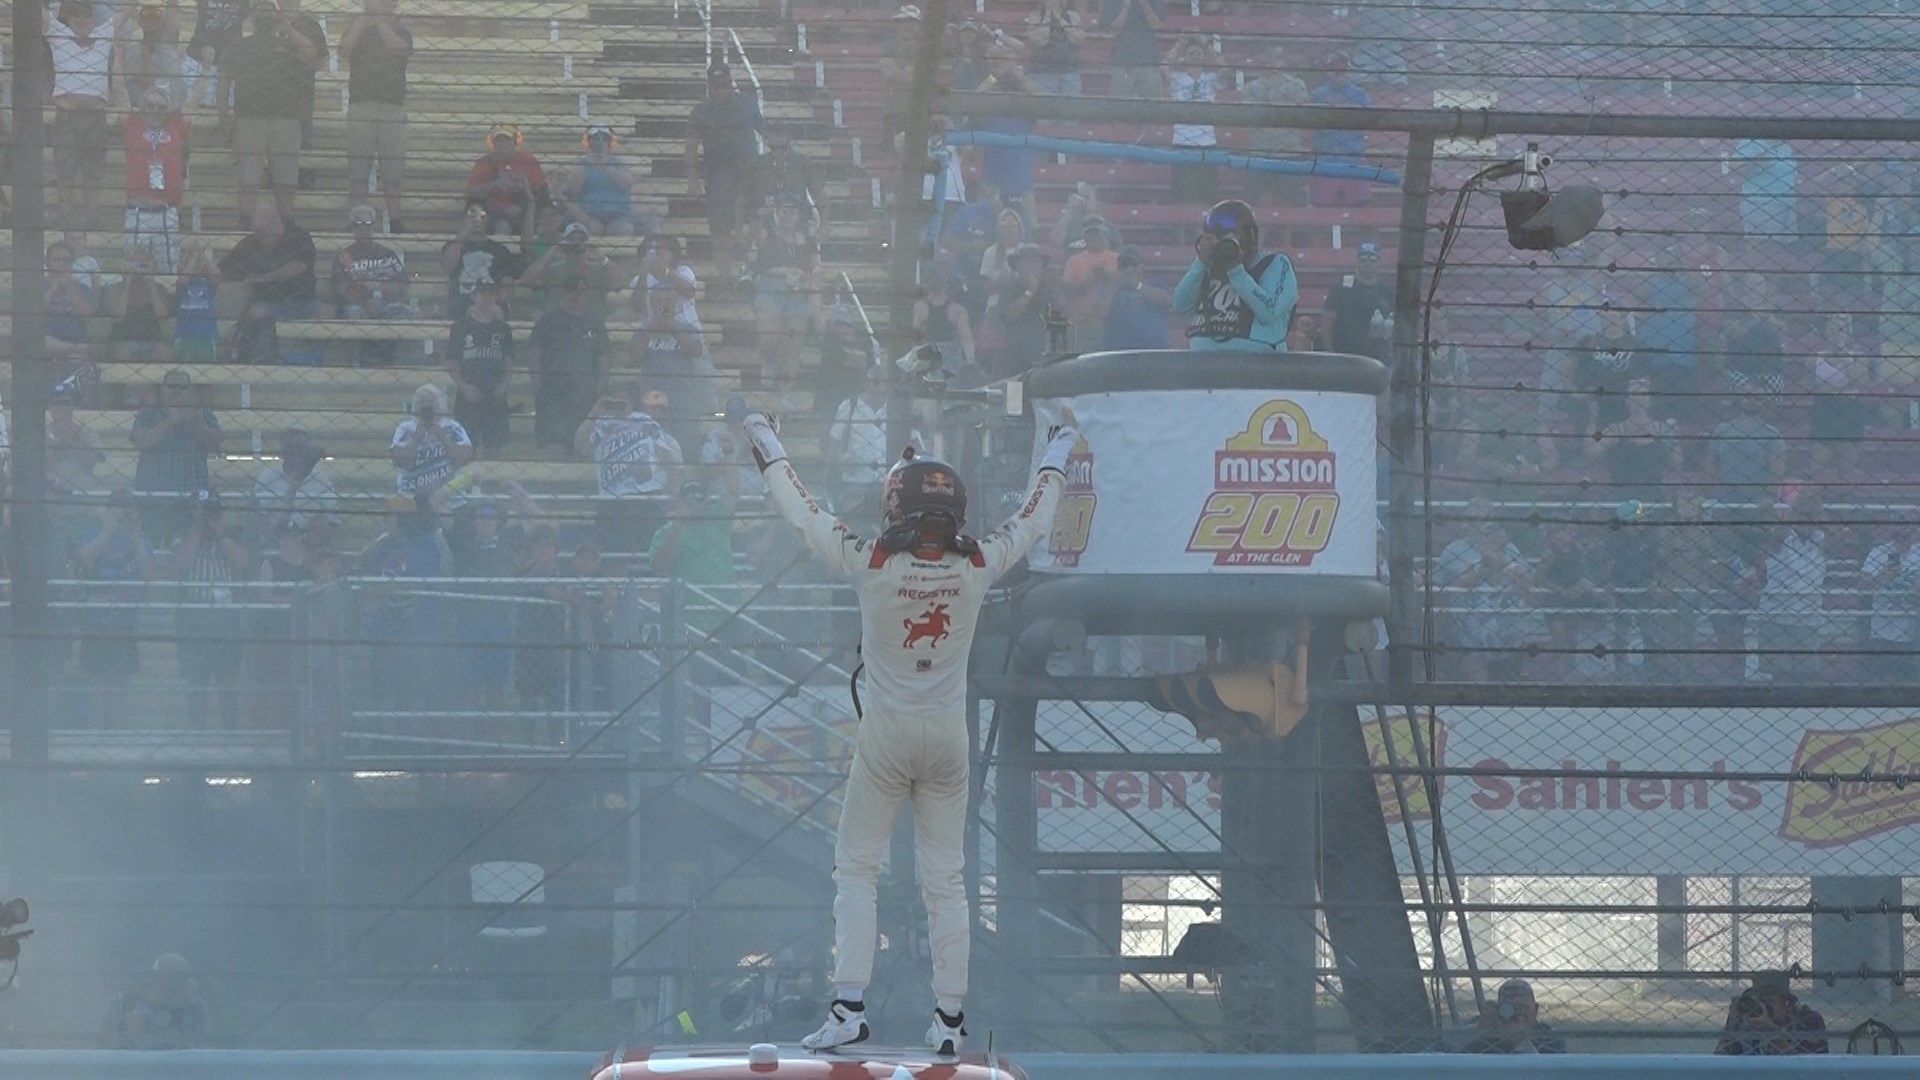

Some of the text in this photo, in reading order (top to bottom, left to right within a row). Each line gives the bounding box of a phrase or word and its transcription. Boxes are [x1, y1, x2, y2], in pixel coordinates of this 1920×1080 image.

[1219, 457, 1332, 483] MISSION
[1187, 491, 1340, 551] 200
[1227, 552, 1302, 563] AT THE GLEN
[1471, 757, 1763, 811] Sahlen's
